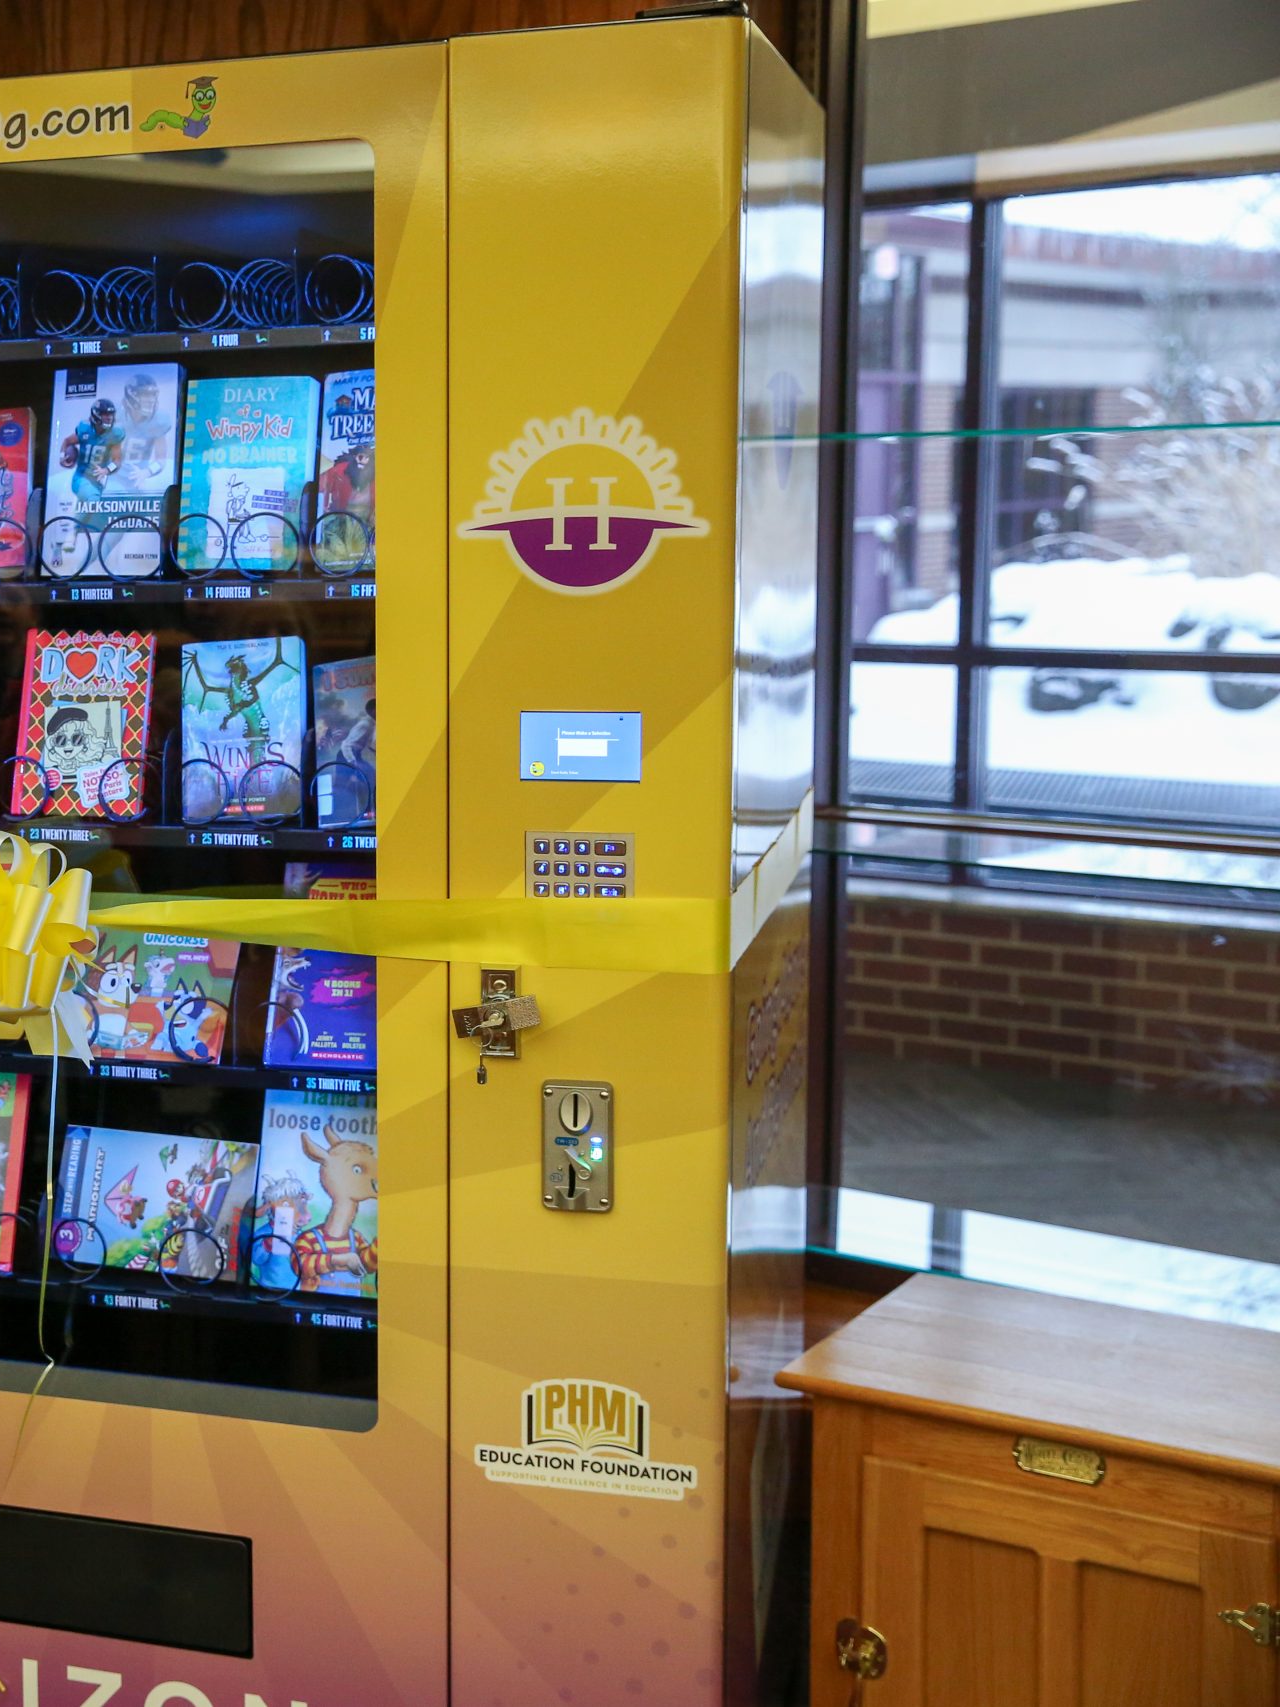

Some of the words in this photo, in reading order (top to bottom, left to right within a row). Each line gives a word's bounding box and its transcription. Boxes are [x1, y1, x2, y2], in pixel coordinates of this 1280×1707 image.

[360, 327, 367, 340] 5
[211, 335, 218, 347] 4
[219, 334, 238, 346] FOUR
[72, 342, 79, 354] 3
[80, 341, 101, 353] THREE
[223, 386, 279, 403] DIARY
[237, 405, 250, 417] of
[206, 417, 262, 443] Wimpy
[263, 414, 293, 438] Kid
[230, 446, 297, 464] BRAINER
[75, 500, 160, 514] JACKSONVILLE
[544, 477, 618, 550] H
[71, 589, 79, 600] 13
[80, 588, 113, 600] THIRTEEN
[205, 587, 214, 598] 14
[215, 586, 251, 598] FOURTEEN
[351, 584, 360, 597] 15
[30, 829, 40, 840] 23
[41, 828, 68, 840] TWENTY
[69, 830, 90, 841] THREE
[202, 833, 212, 844] 25
[213, 833, 242, 845] TWENTY
[242, 834, 259, 846] FIVE
[342, 836, 353, 848] 26
[539, 843, 544, 852] 1
[558, 843, 565, 852] 2
[578, 844, 586, 852] 3
[558, 864, 565, 873] 5
[340, 882, 367, 891] WHO
[538, 886, 545, 894] 7
[578, 887, 586, 896] 9
[601, 888, 618, 897] Exit
[146, 933, 206, 946] UNICORSE
[100, 1065, 110, 1076] 33
[111, 1065, 136, 1078] THIRTY
[136, 1067, 158, 1080] THREE
[306, 1078, 316, 1089] 35
[318, 1078, 344, 1091] THIRTY
[345, 1079, 361, 1092] FIVE
[269, 1108, 320, 1131] loose
[67, 1139, 82, 1177] READING
[63, 1191, 73, 1213] STEP
[59, 1229, 74, 1241] 3
[104, 1295, 114, 1306] 43
[115, 1295, 137, 1308] FORTY
[138, 1298, 158, 1310] THREE
[311, 1313, 321, 1325] 45
[323, 1314, 346, 1327] FORTY
[346, 1316, 363, 1329] FIVE
[545, 1383, 626, 1437] PHM
[479, 1449, 575, 1471] EDUCATION
[580, 1460, 692, 1483] FOUNDATION
[490, 1470, 547, 1483] SUPPORTING
[550, 1476, 608, 1489] EXCELLENCE
[611, 1482, 621, 1490] IN
[624, 1484, 680, 1496] EDUCATION
